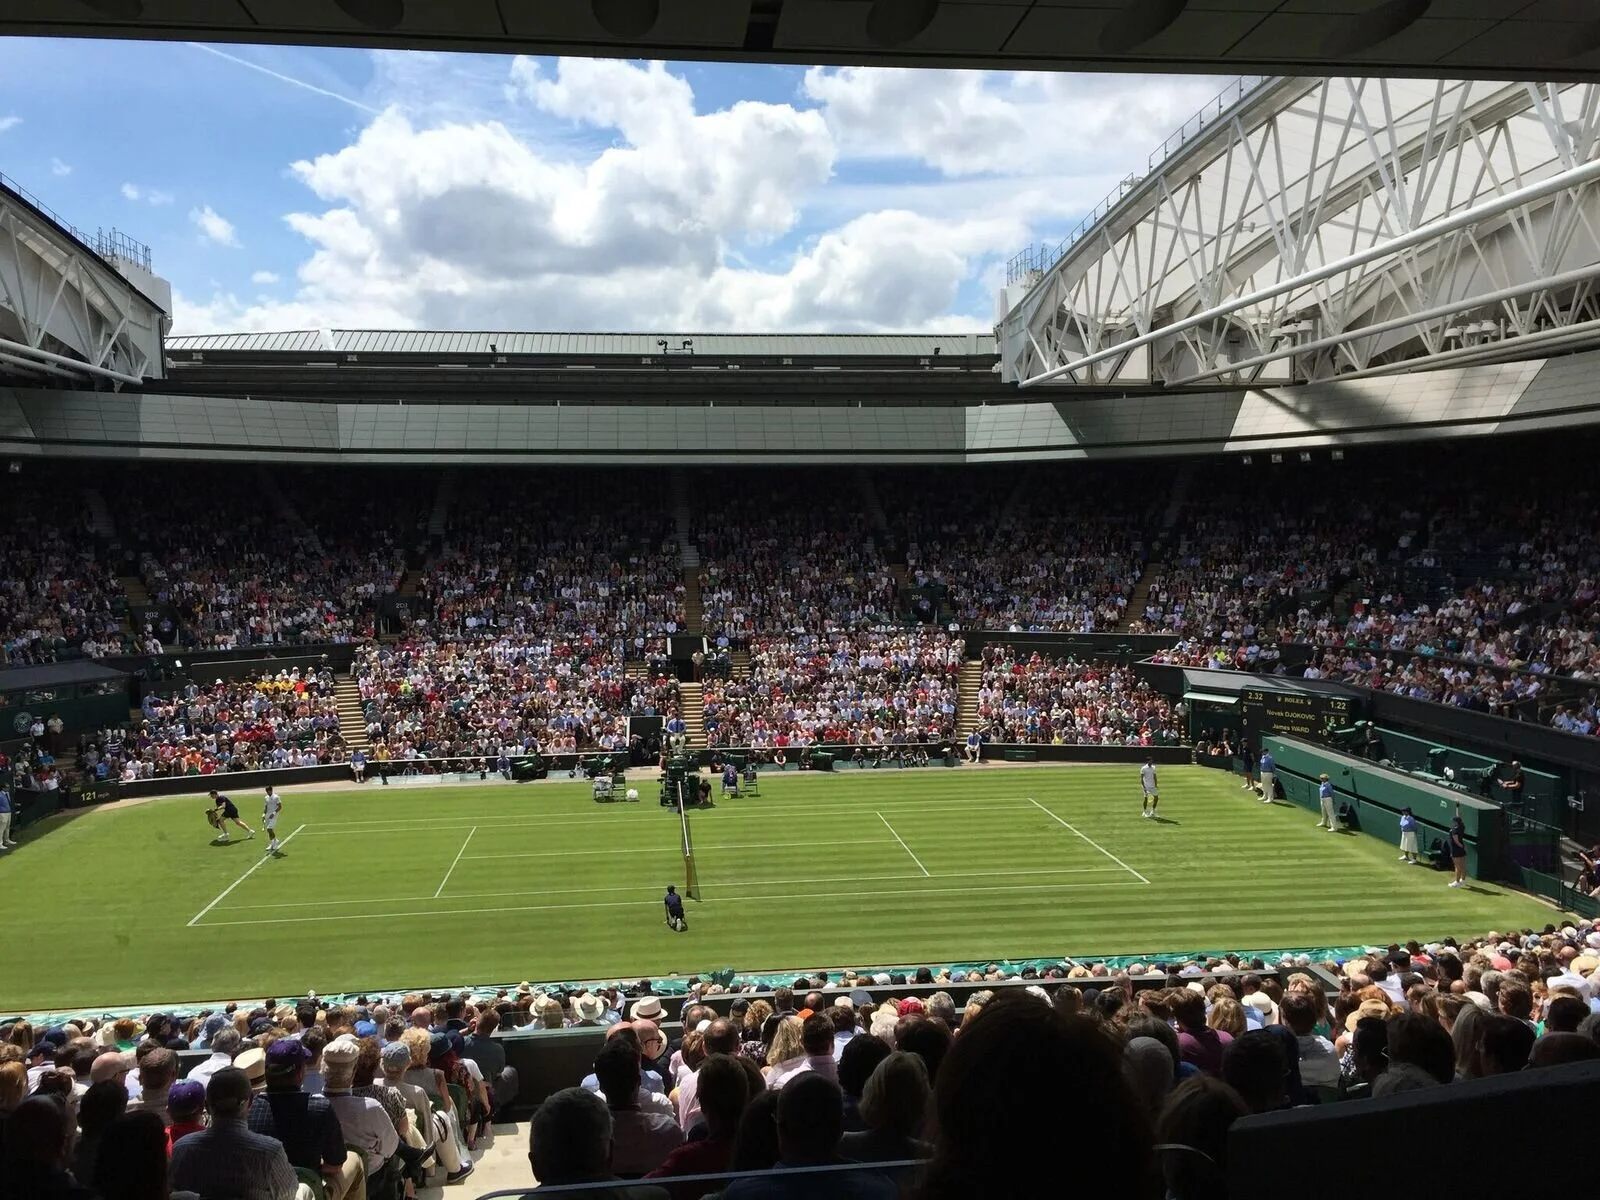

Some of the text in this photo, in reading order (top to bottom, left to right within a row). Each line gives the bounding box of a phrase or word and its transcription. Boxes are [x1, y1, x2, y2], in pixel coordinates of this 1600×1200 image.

[144, 611, 159, 620] 202
[1248, 692, 1264, 701] 2.32
[1330, 701, 1346, 710] 1.22
[1266, 709, 1284, 717] Novak
[1284, 711, 1316, 721] DJOKOVIC
[1272, 723, 1291, 731] James
[80, 791, 96, 801] 121
